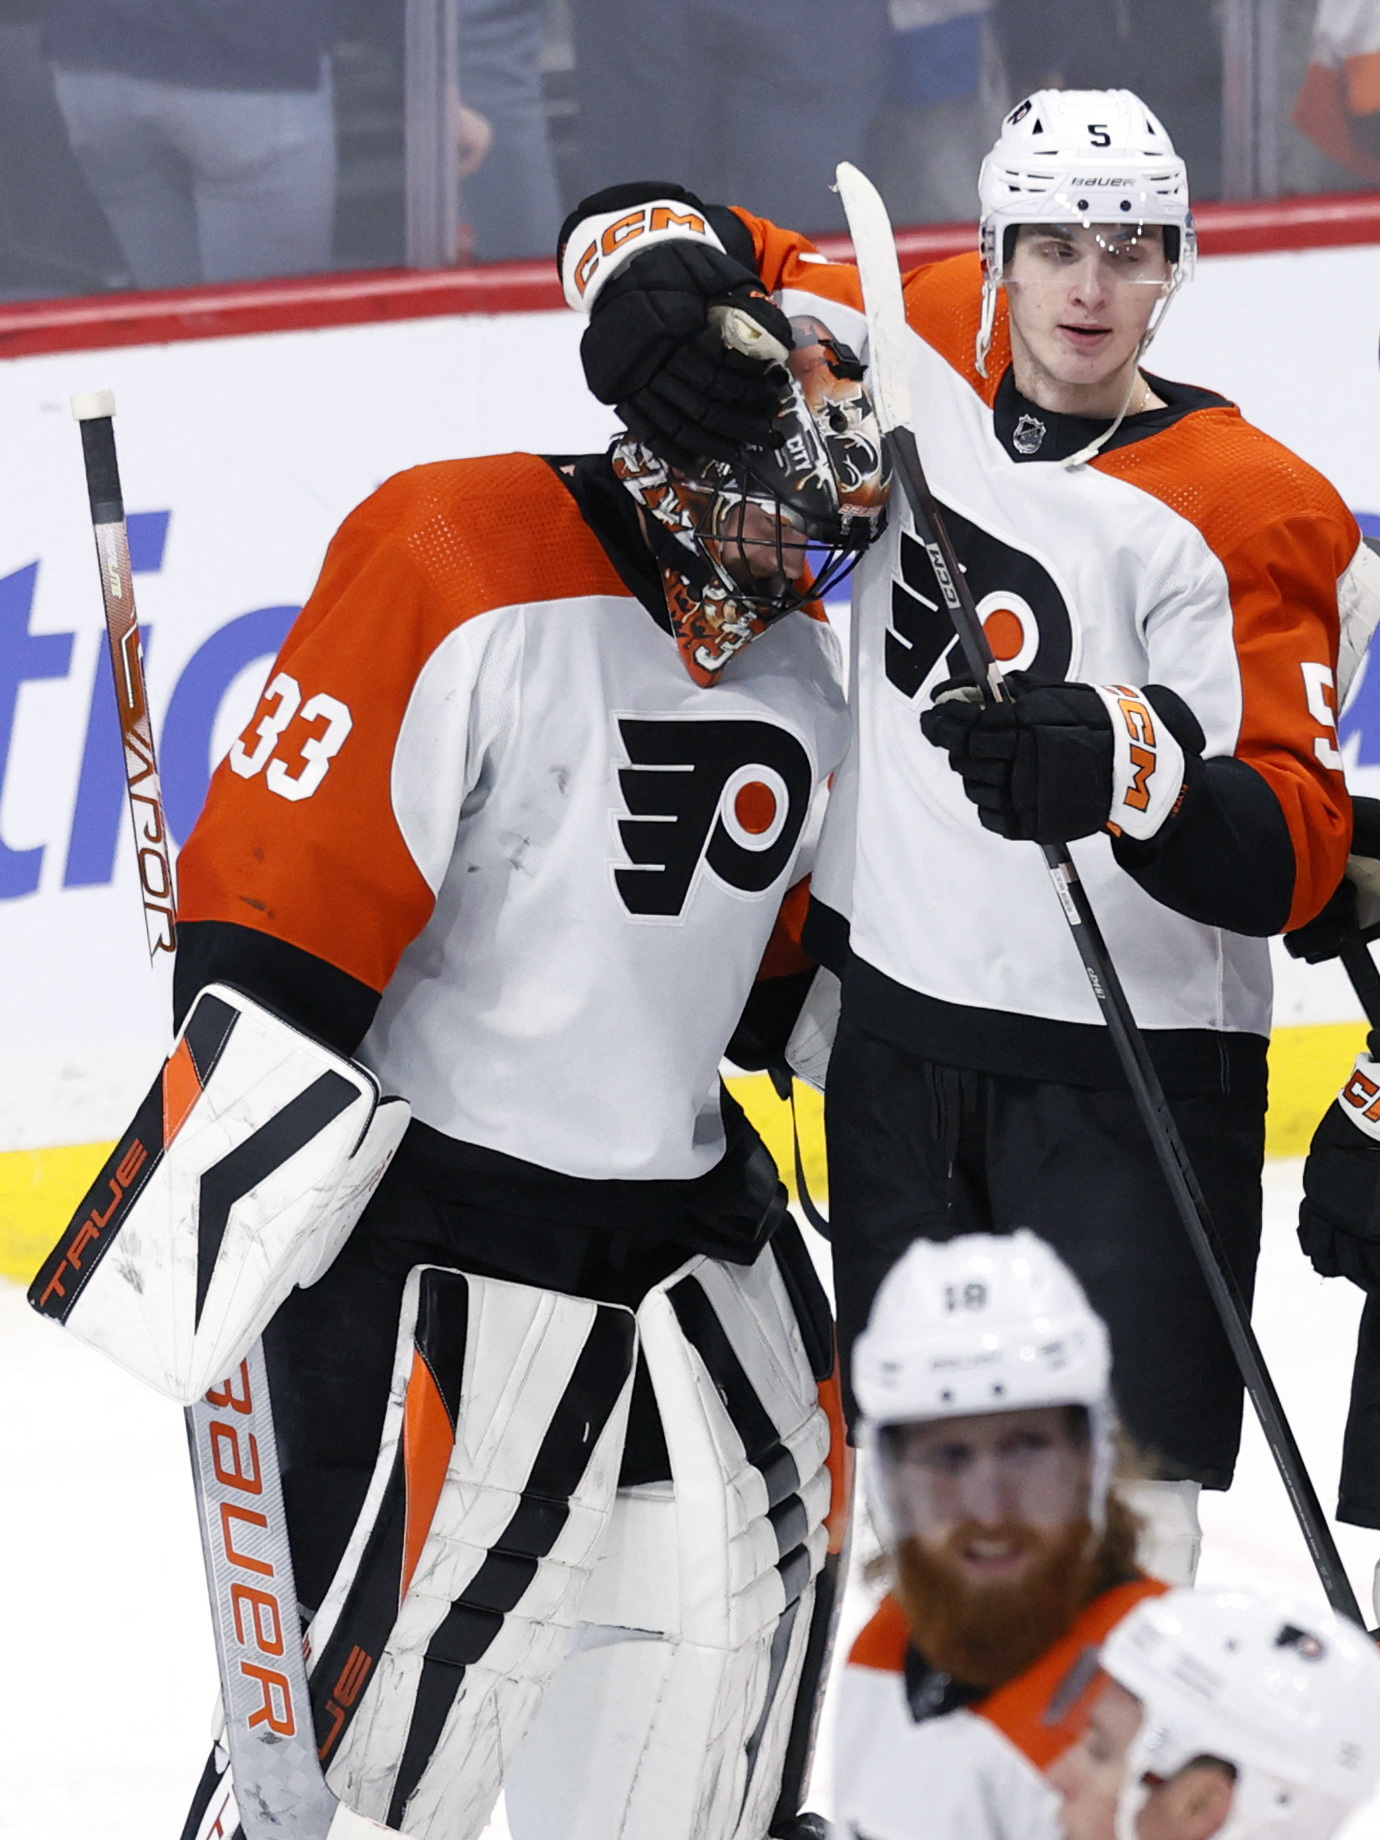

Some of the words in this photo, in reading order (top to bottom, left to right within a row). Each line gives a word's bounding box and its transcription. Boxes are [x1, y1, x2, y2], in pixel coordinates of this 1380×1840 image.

[1087, 125, 1111, 147] 5
[573, 206, 706, 299] CCM
[786, 436, 813, 471] CITY
[929, 548, 957, 603] CCM
[229, 671, 354, 802] 33
[1101, 684, 1157, 813] CM
[1300, 662, 1344, 771] 5
[39, 1137, 149, 1307] TRUE
